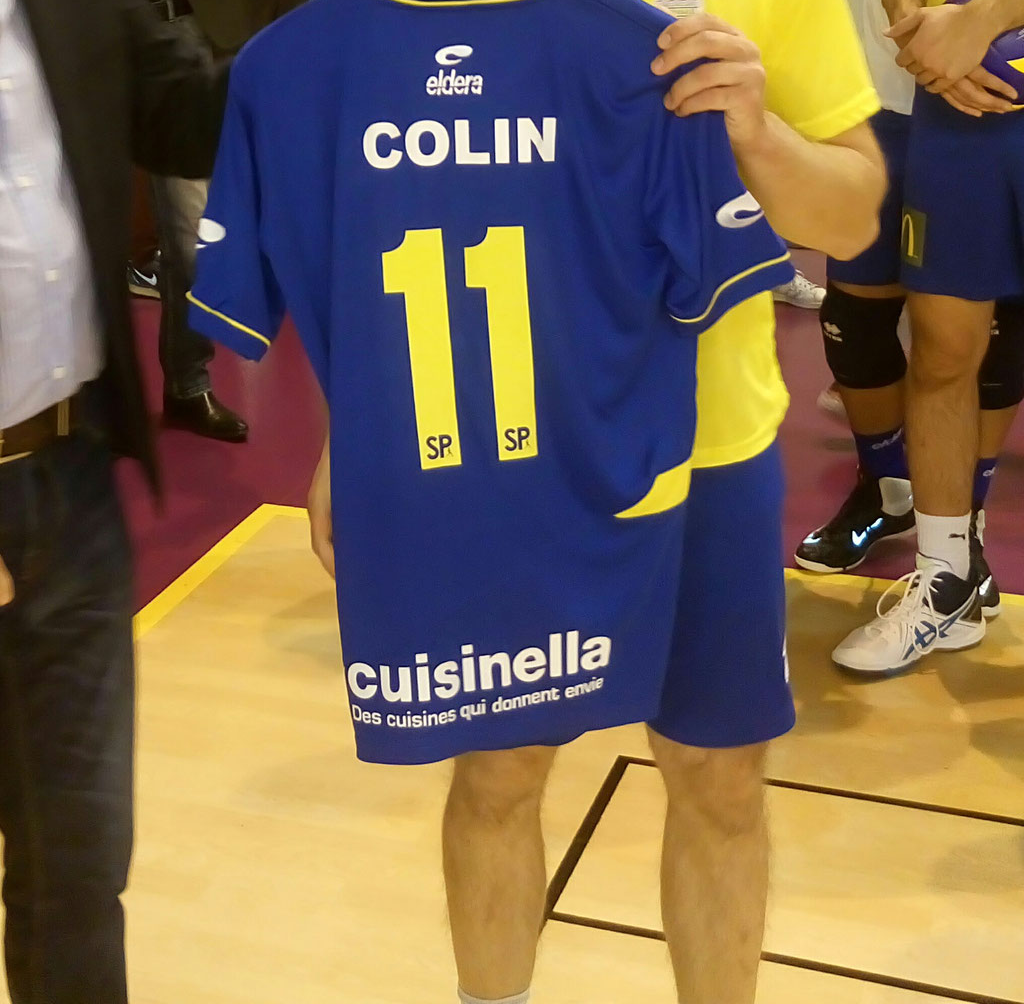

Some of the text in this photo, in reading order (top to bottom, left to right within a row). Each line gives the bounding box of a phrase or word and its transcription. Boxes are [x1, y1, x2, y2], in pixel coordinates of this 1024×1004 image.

[426, 69, 484, 96] eldera
[362, 117, 557, 170] COLIN
[382, 226, 538, 470] 11
[347, 630, 612, 701] cuisinella
[352, 676, 605, 728] Des cuisines qui donnent envie
